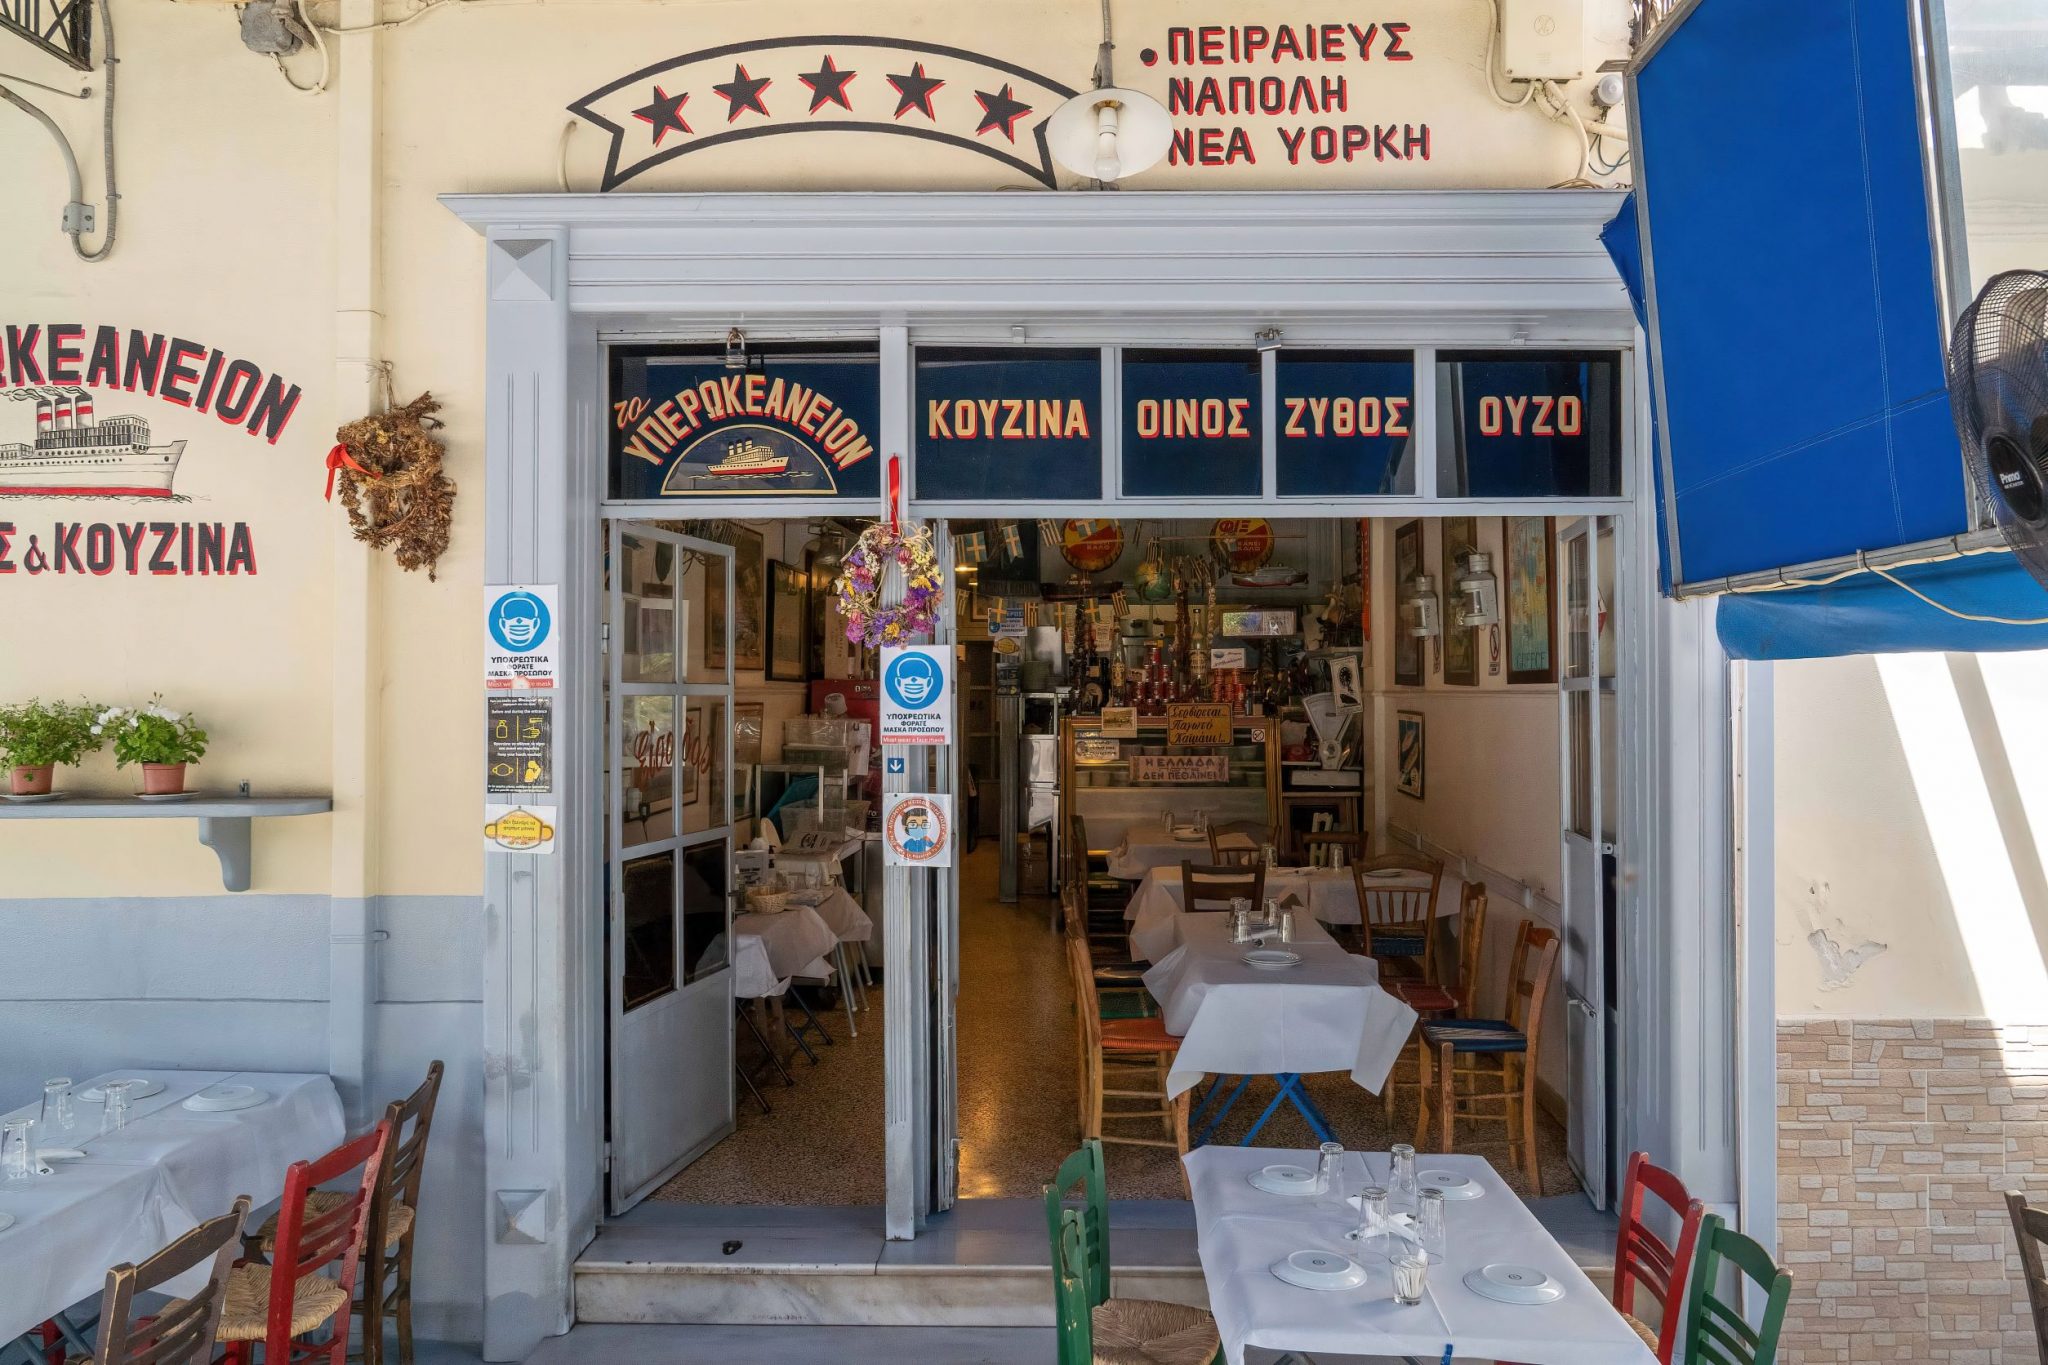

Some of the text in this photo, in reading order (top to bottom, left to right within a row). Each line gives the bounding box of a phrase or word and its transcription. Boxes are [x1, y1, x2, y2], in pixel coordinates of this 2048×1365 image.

[1168, 22, 1413, 64] ΠΕΙΡΑΙΕΥΣ
[1168, 75, 1347, 116] ΝΑΠΟΛΗ
[1168, 123, 1431, 166] ΝΕΑ ΥΟΡΚΗ
[0, 323, 302, 446] ΚΕΑΝΕΙΟΝ
[623, 374, 874, 471] ΥΠΕΡΩΚΕΑΝΕΙΟΝ
[928, 399, 1090, 439] ΚΟΥΖΙΝΑ
[1137, 398, 1250, 438] ΟΙΝΟΣ
[1284, 397, 1409, 437] ΖΥΘΟΣ
[1479, 395, 1582, 436] ΟΥΖΟ
[24, 534, 50, 576] &
[54, 522, 257, 576] ΚΟΥΖΙΝΑ
[491, 655, 549, 664] ΥΠΟΧΡΕΩΤΙΚΑ
[1143, 771, 1164, 780] ΔΕΝ
